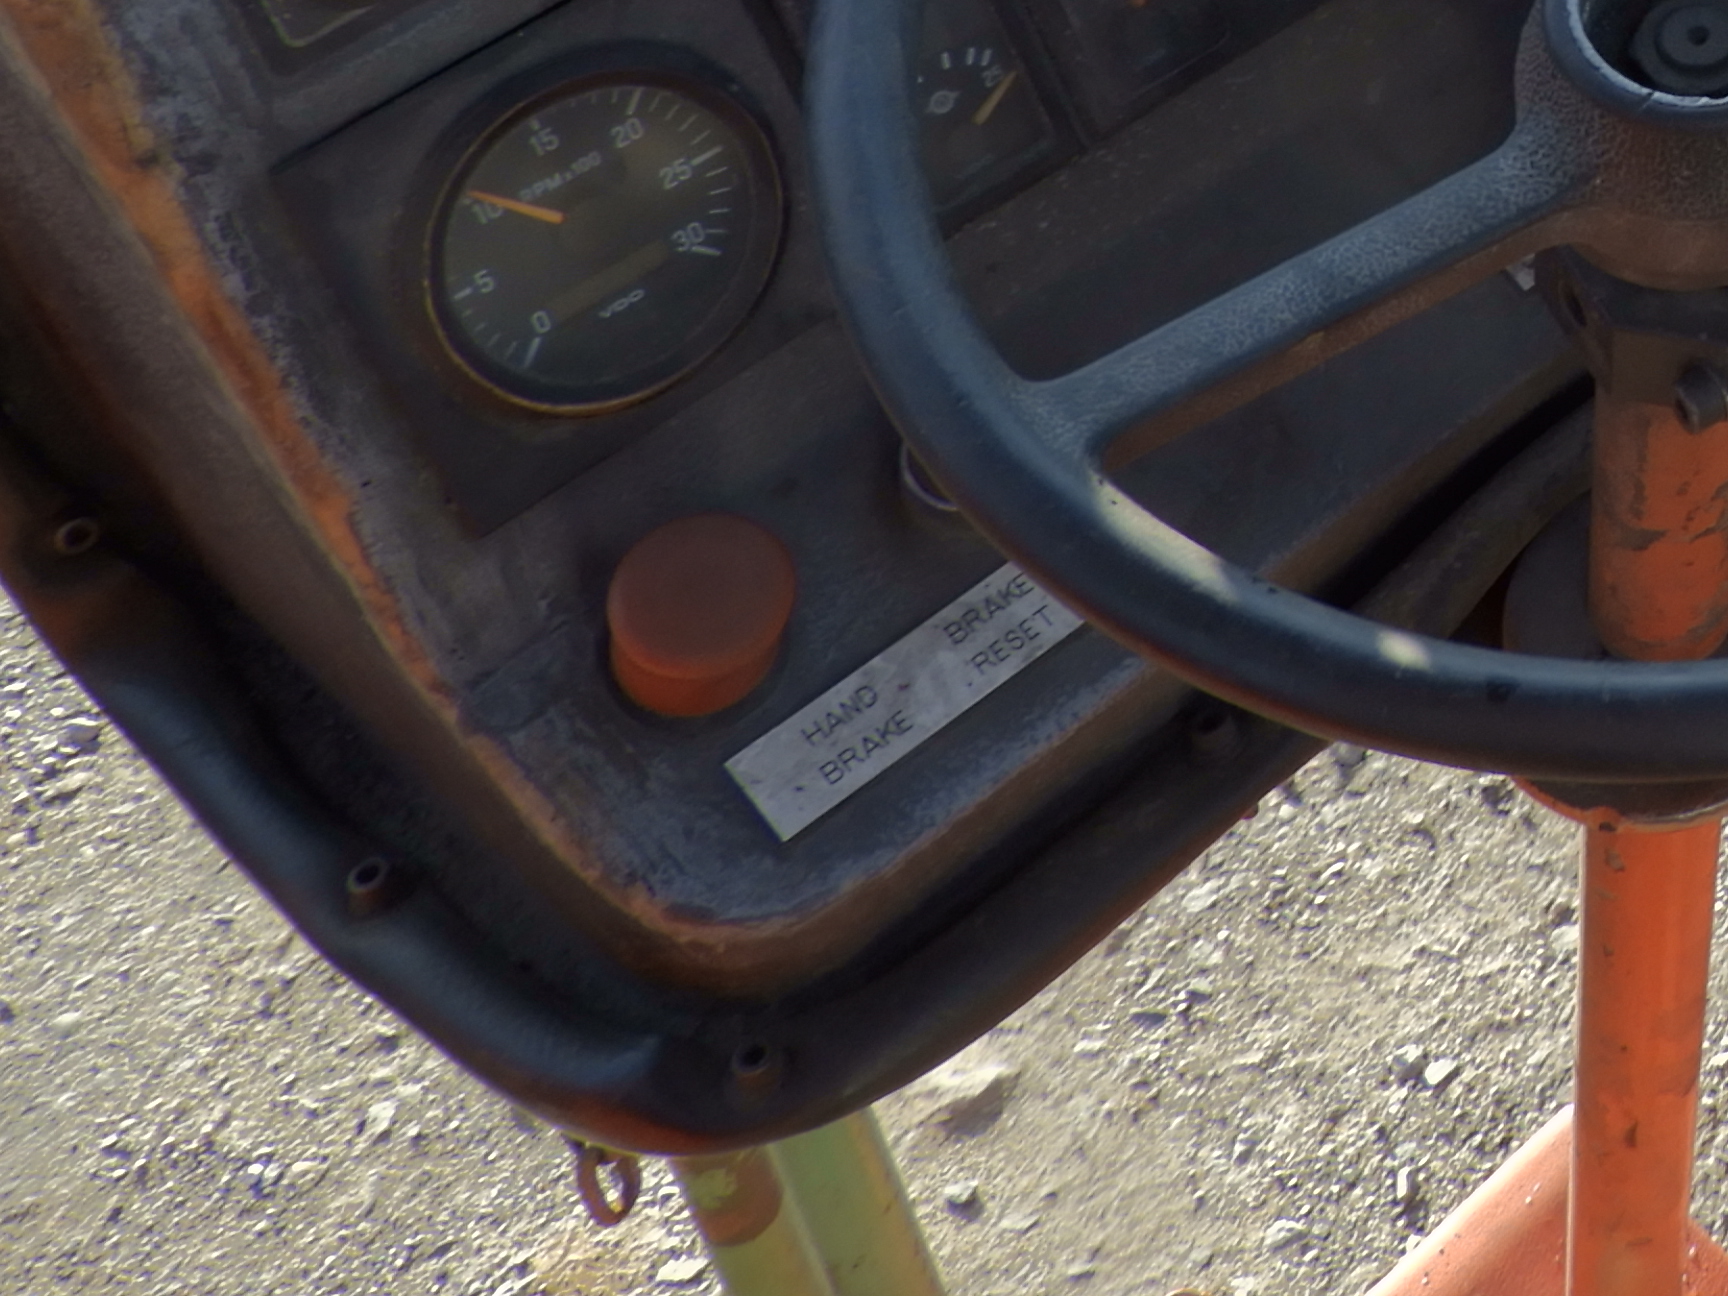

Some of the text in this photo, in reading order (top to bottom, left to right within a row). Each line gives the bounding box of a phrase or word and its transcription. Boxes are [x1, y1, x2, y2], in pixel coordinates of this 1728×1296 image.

[529, 128, 559, 156] 15
[610, 117, 644, 149] 20
[659, 158, 692, 190] 25
[670, 222, 706, 252] 30
[473, 269, 494, 294] 5
[598, 288, 645, 318] VDO
[530, 310, 551, 334] 0
[944, 571, 1034, 645] BRAKE
[970, 604, 1053, 675] RESET
[800, 685, 877, 746] HAND
[818, 709, 913, 784] BRAKE
